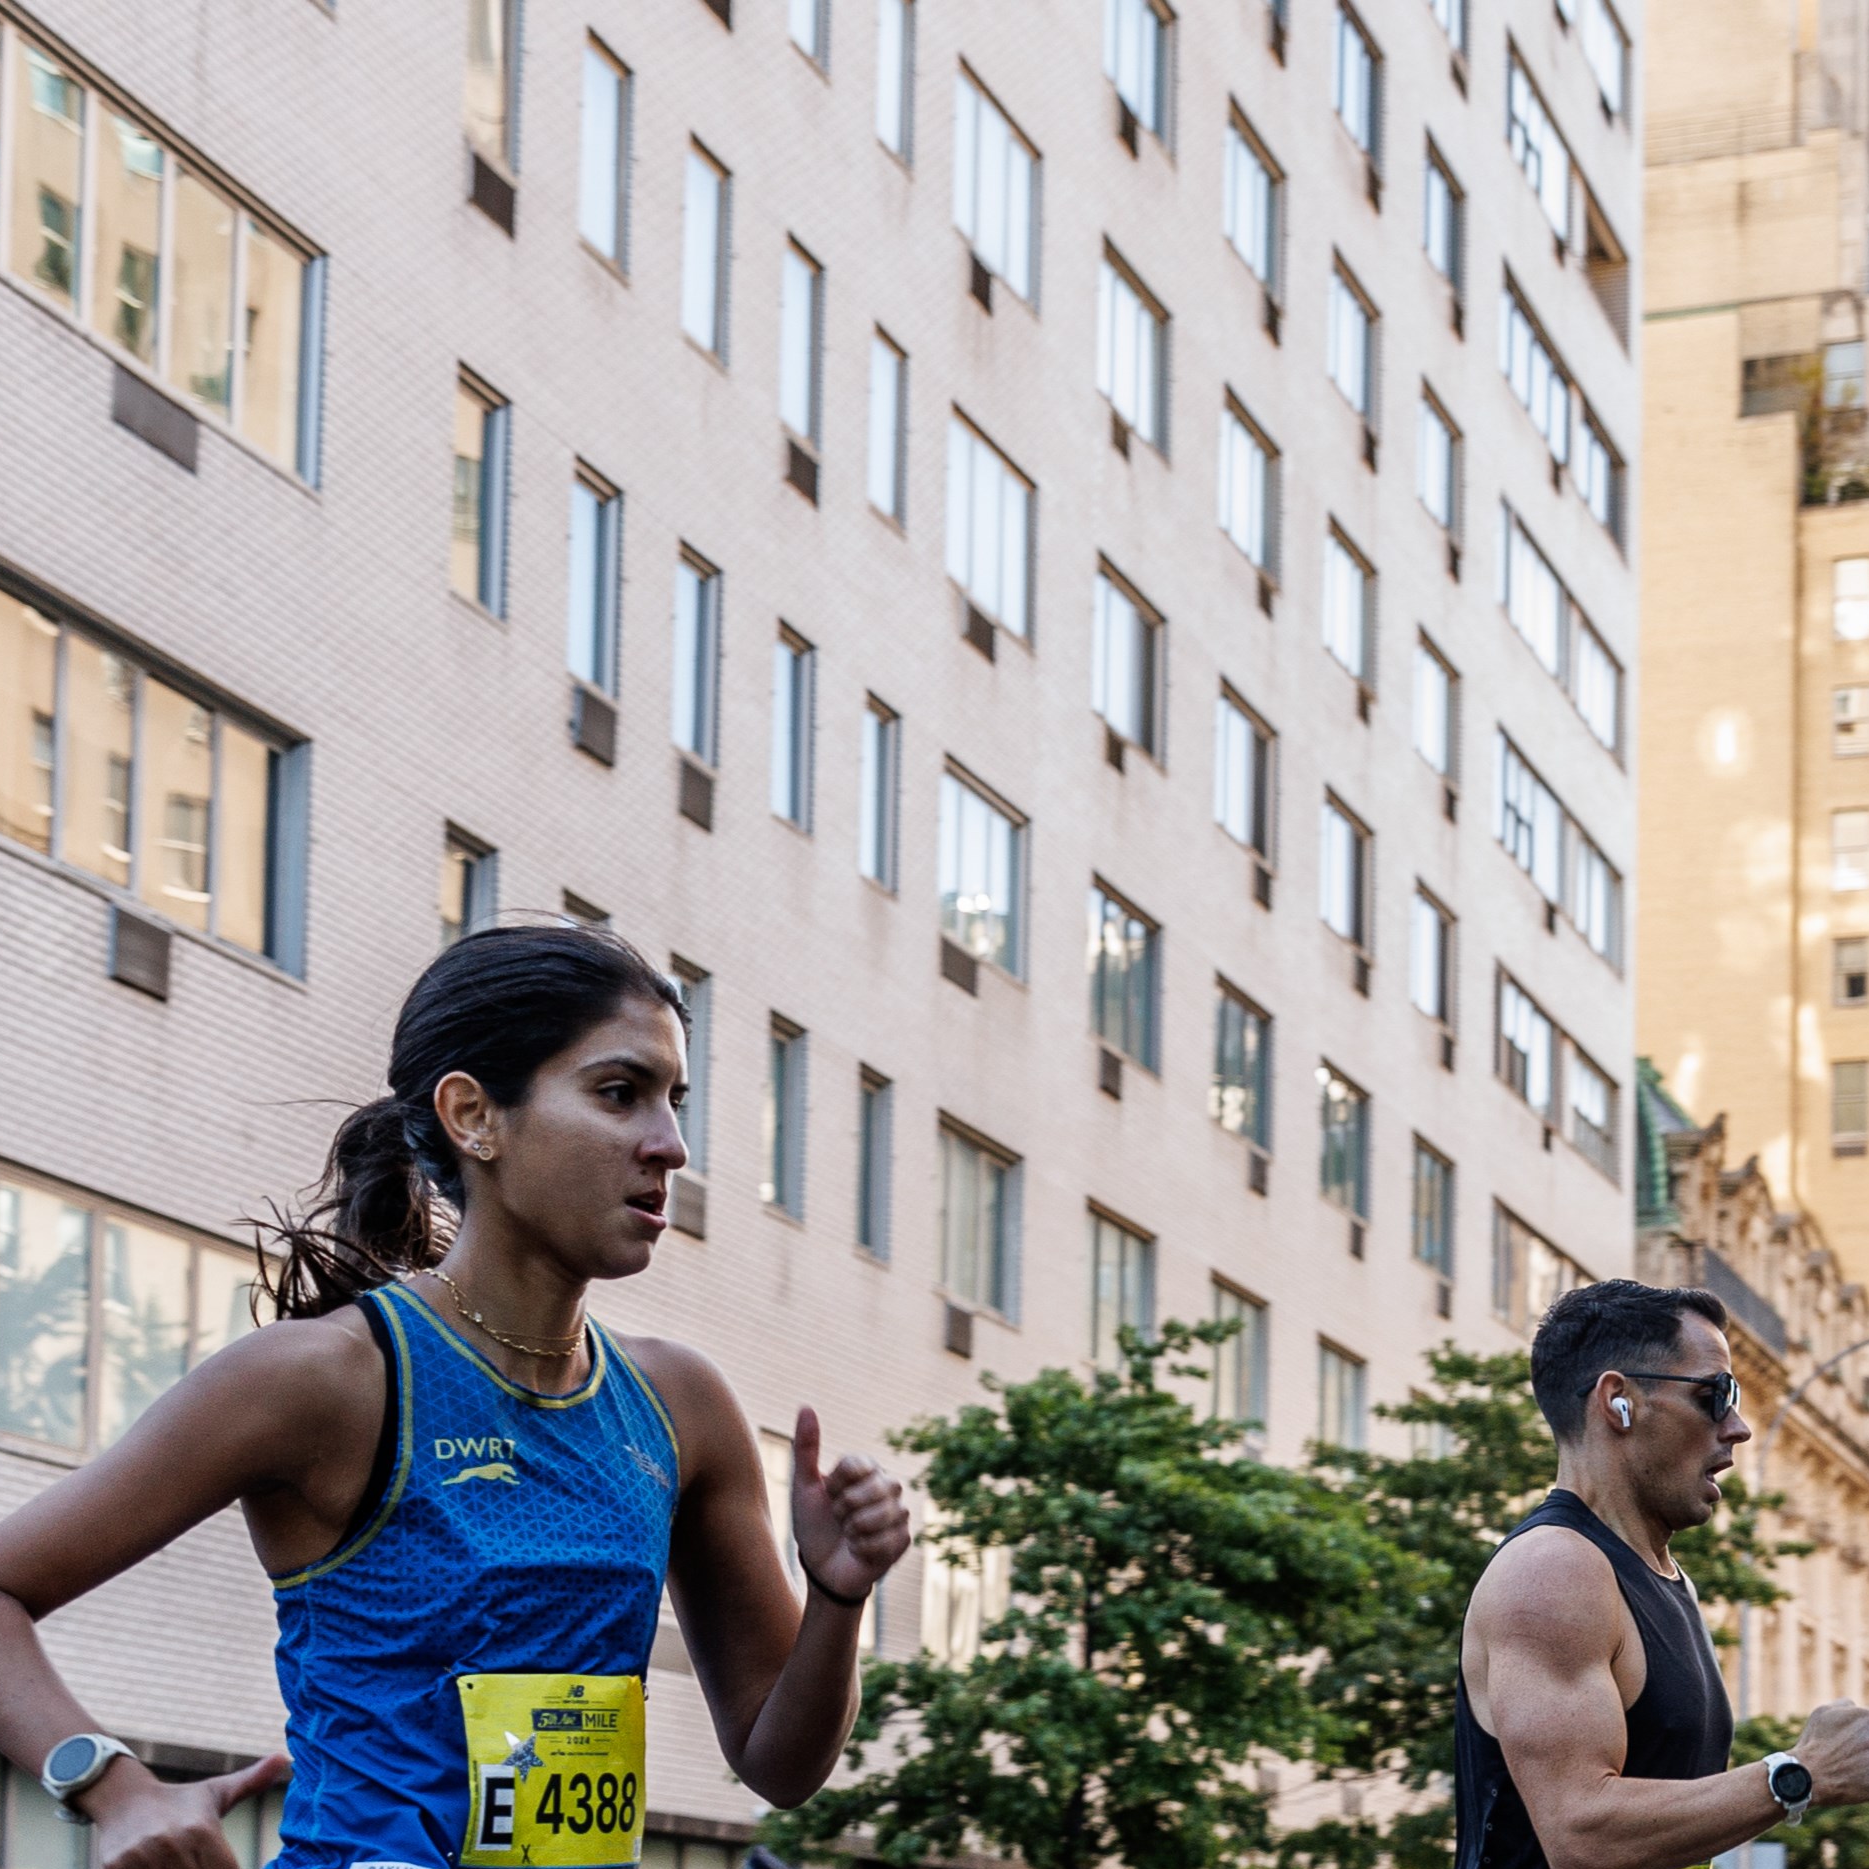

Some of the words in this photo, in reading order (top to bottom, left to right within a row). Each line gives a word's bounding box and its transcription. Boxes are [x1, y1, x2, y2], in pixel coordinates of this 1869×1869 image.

[585, 1714, 617, 1728] MILE
[481, 1777, 515, 1844] E
[536, 1772, 637, 1834] 4388
